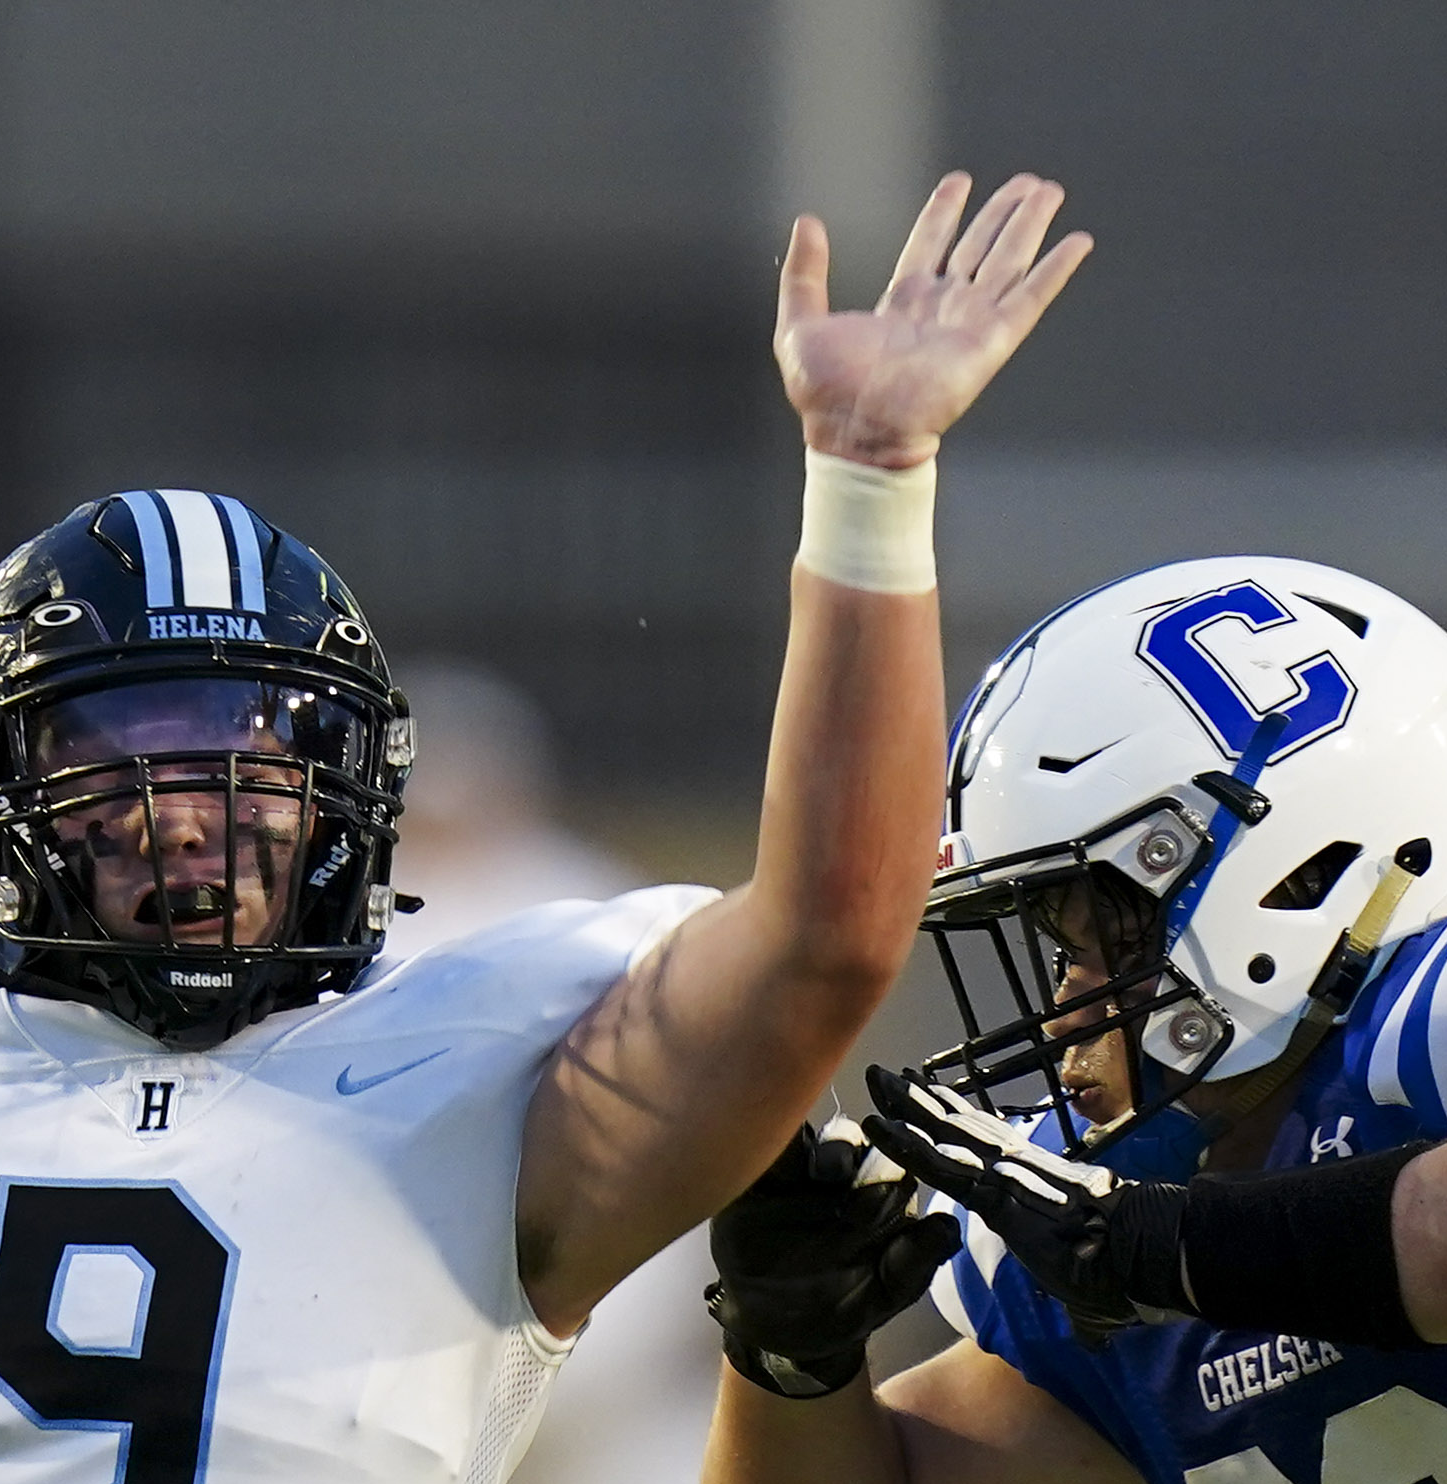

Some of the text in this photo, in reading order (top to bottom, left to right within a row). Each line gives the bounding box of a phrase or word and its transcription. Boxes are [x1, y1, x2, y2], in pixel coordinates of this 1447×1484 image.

[147, 614, 267, 642] HELENA
[1135, 579, 1357, 766] C
[169, 971, 233, 988] Riddell
[135, 1081, 175, 1131] H
[1197, 1334, 1344, 1412] CHELSEA
